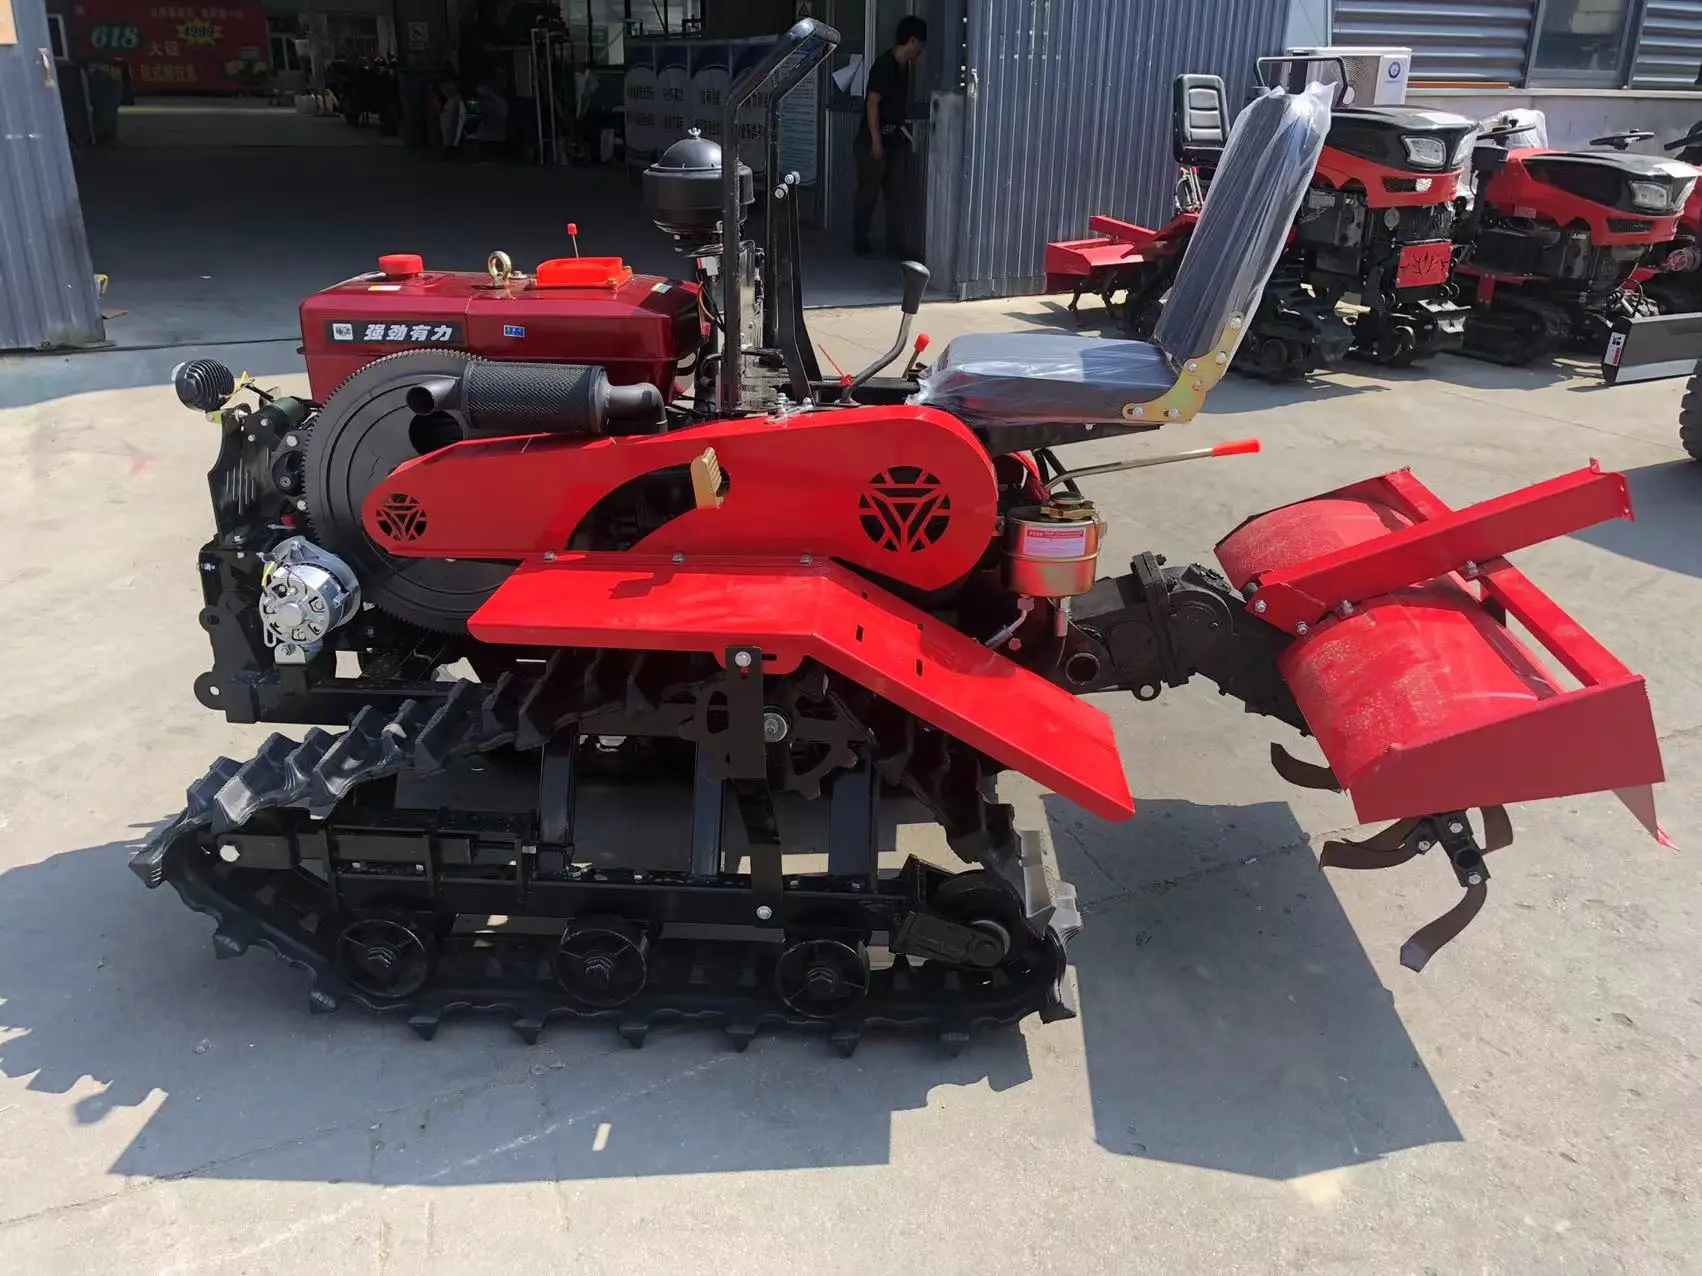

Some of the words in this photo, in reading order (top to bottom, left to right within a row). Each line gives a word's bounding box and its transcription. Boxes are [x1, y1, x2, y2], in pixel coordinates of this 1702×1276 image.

[91, 26, 139, 48] 618
[363, 323, 453, 342] 强劲有力
